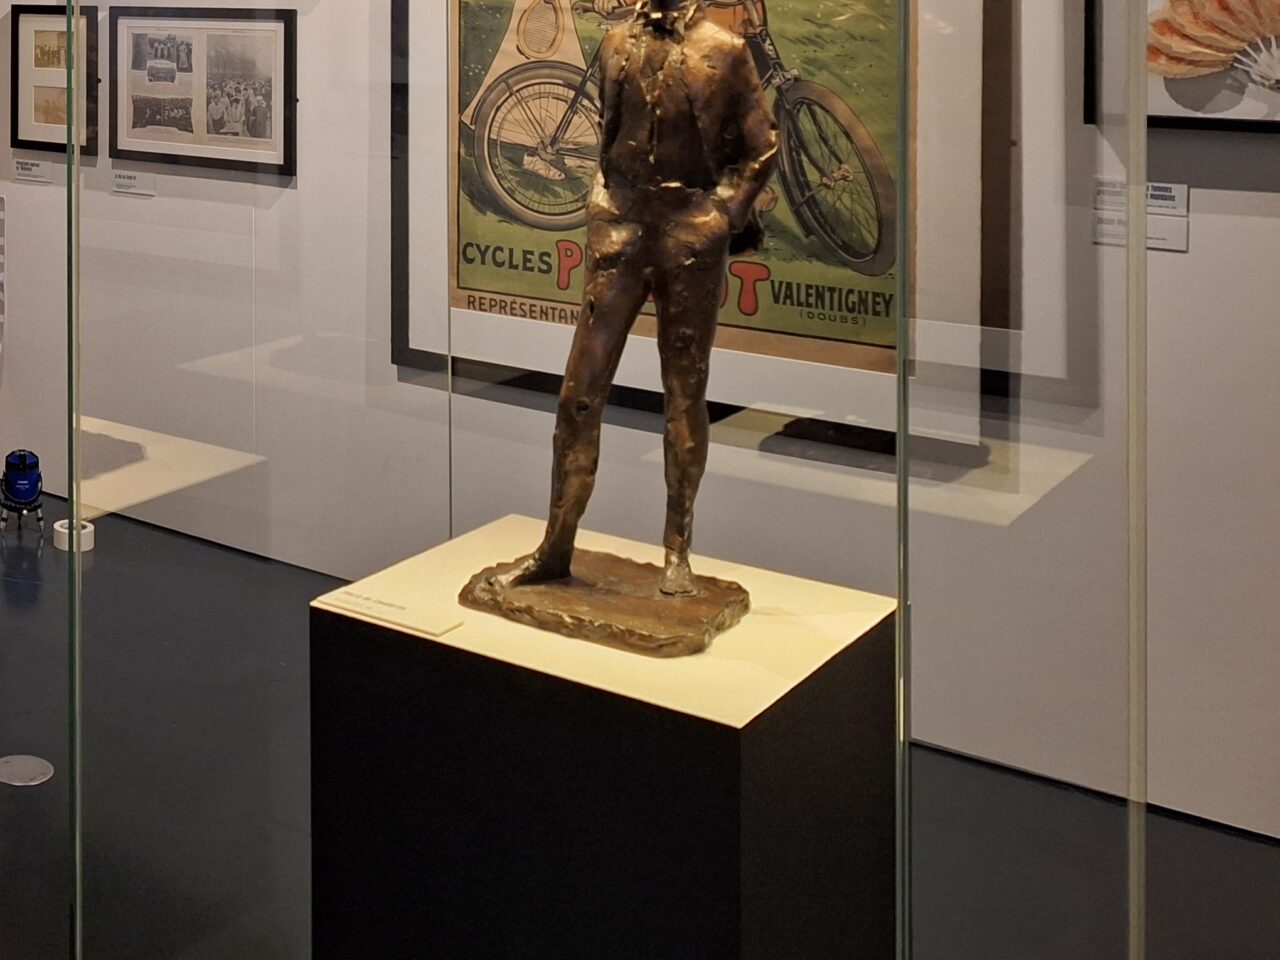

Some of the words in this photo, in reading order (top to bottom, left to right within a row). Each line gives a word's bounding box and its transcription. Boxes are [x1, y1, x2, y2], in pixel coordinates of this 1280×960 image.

[462, 241, 553, 275] CYCLES
[467, 295, 580, 326] REPRÉSENTAN
[770, 279, 895, 318] VALENTIGNEY
